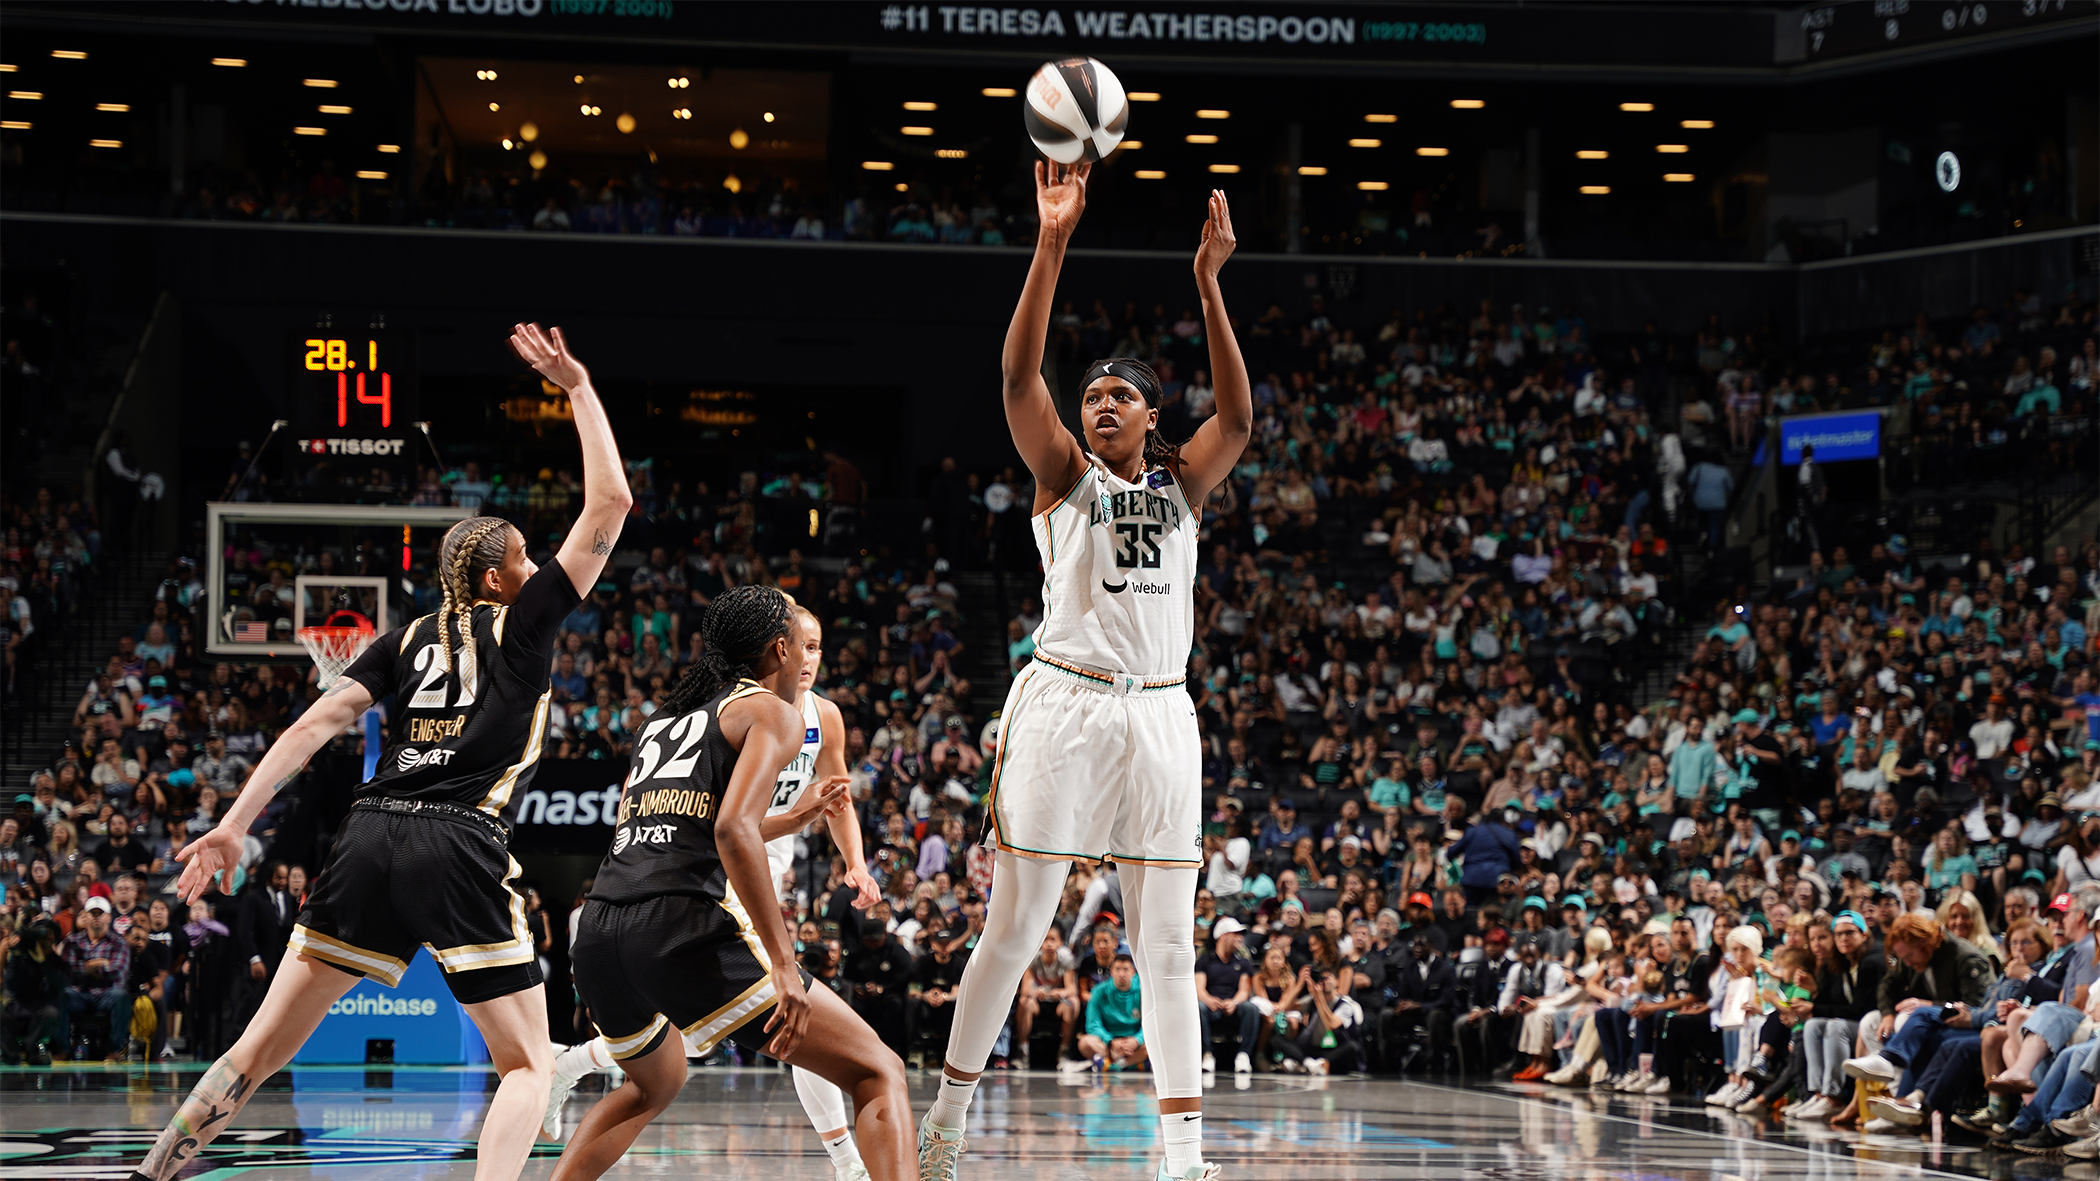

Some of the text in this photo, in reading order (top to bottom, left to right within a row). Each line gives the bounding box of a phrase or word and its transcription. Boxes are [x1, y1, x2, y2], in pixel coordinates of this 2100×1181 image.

[880, 5, 930, 32] #11
[938, 6, 1067, 36] TERESA
[1073, 11, 1356, 44] WEATHERSPOON
[1941, 3, 1988, 31] 0/0
[304, 338, 378, 372] 28.1
[337, 371, 392, 428] 14
[1115, 523, 1163, 569] 35
[1132, 581, 1171, 595] Webull
[407, 639, 478, 709] 21
[626, 709, 709, 789] 32
[631, 823, 678, 846] AT&T
[328, 991, 437, 1017] coinbase
